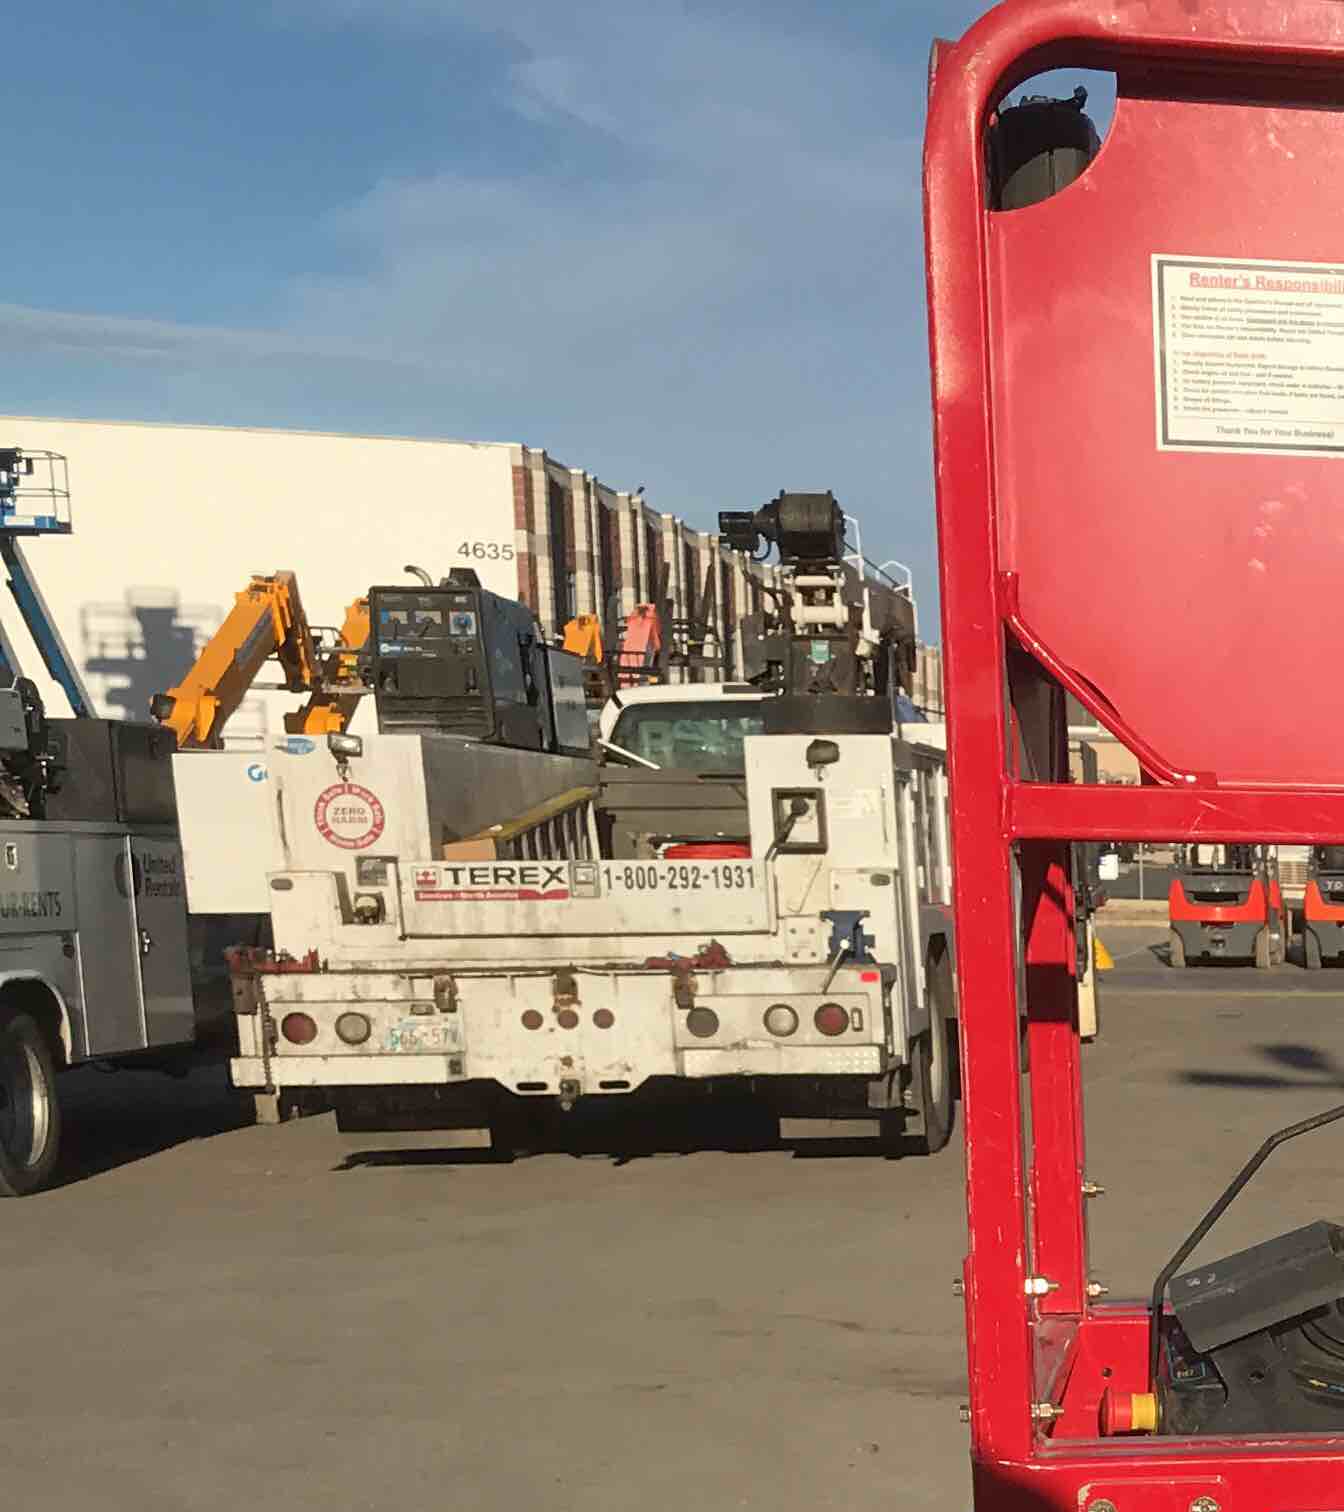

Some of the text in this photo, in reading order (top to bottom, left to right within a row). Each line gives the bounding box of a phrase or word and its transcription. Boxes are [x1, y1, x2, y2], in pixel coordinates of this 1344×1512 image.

[457, 541, 515, 561] 4635
[333, 807, 366, 816] ZERO
[443, 864, 756, 890] TEREX 1-800-292-1931
